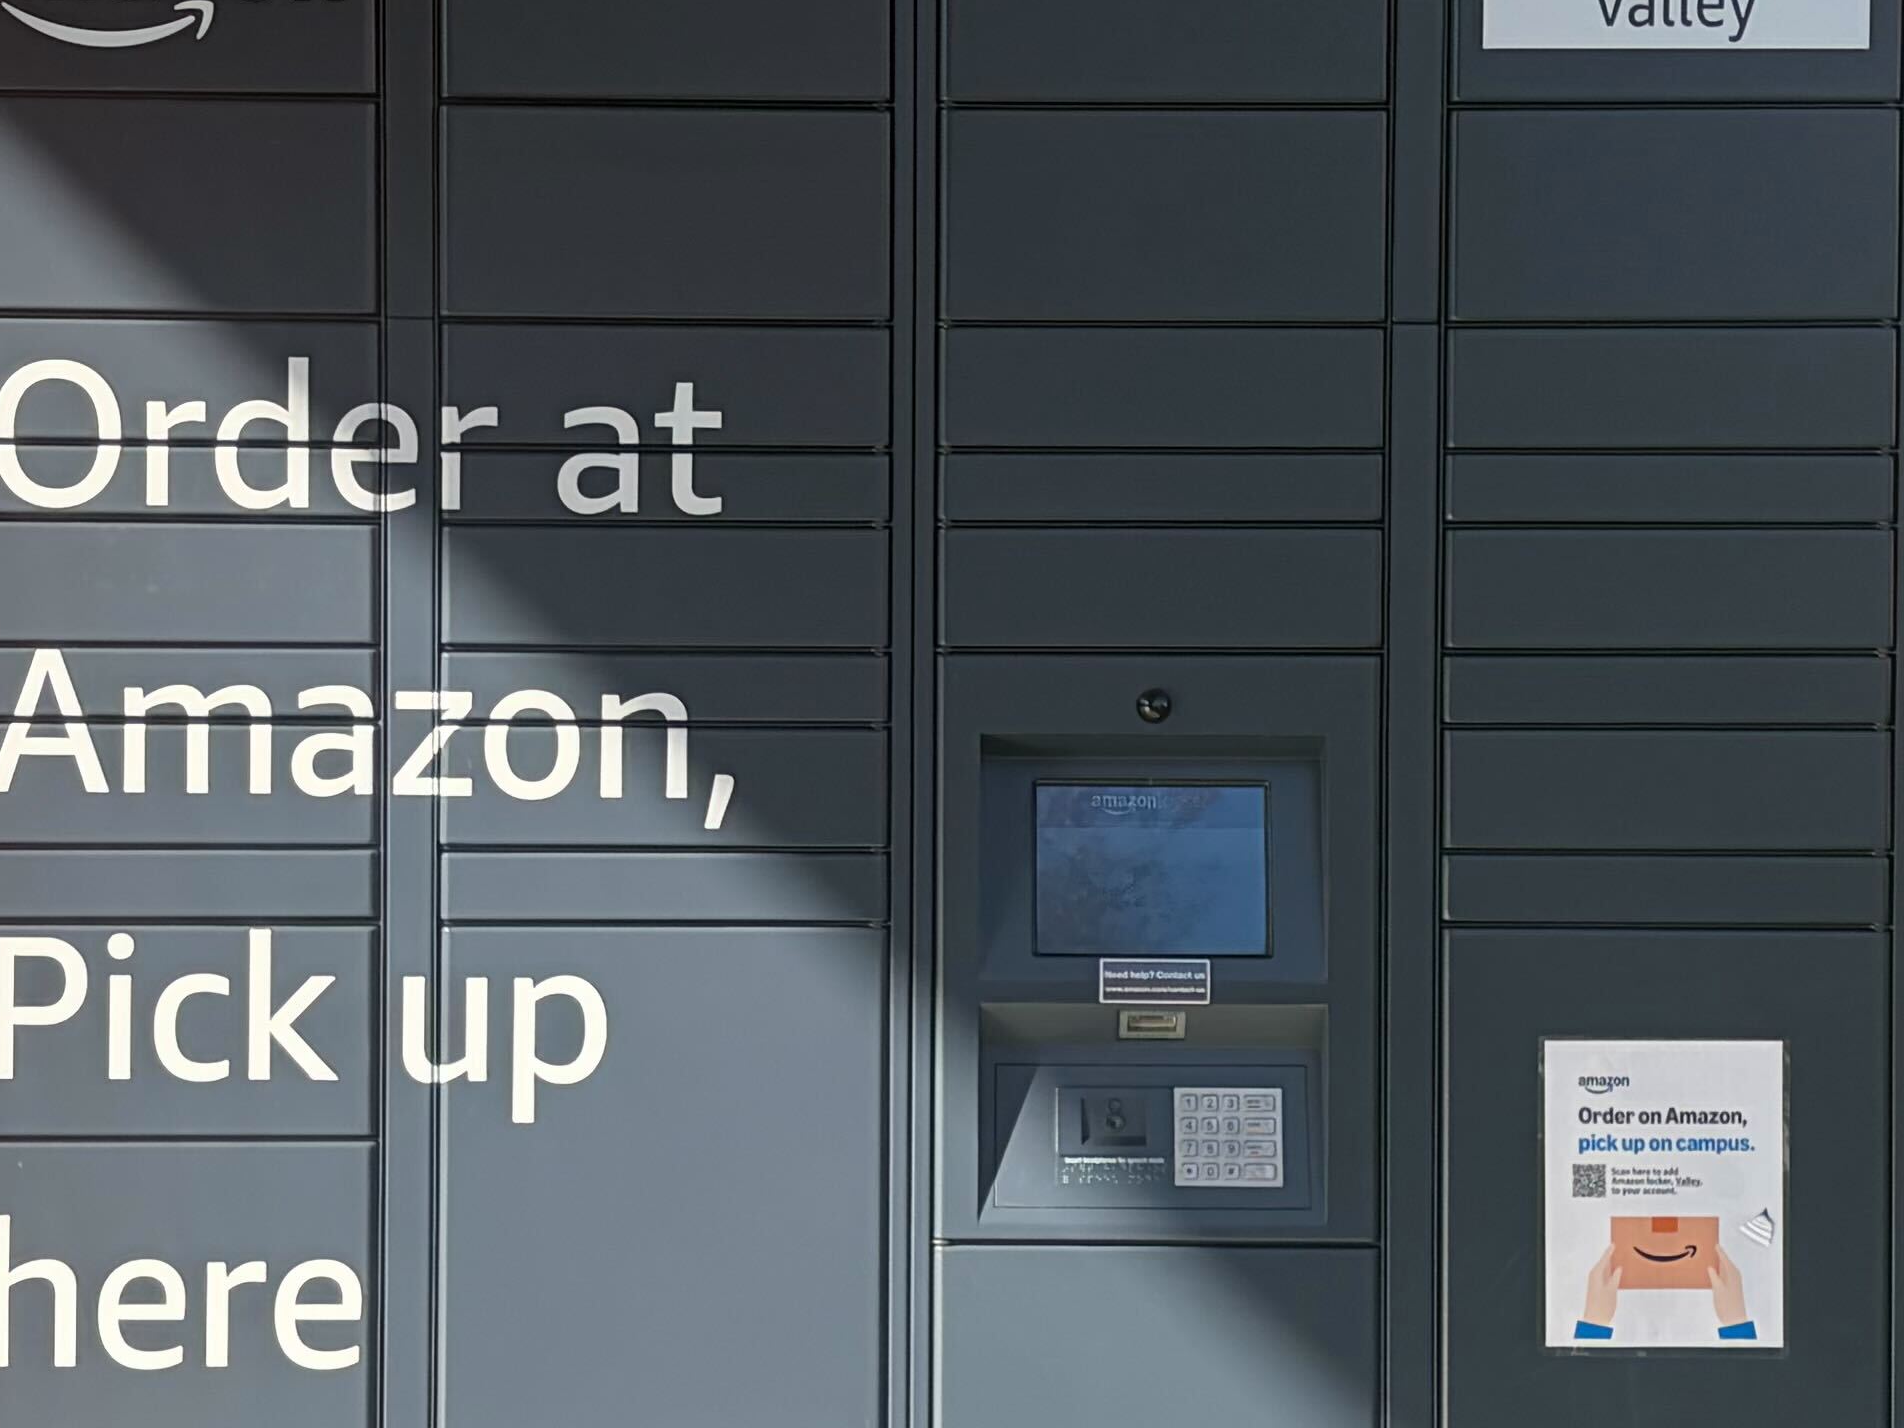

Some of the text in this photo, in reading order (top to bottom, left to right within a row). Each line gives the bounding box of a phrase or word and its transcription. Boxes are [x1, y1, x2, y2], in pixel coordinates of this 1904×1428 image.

[557, 382, 723, 515] at
[1090, 794, 1157, 809] amazon
[1104, 971, 1128, 979] Need
[1130, 970, 1154, 980] help?
[1156, 971, 1192, 979] Contact
[401, 974, 609, 1124] up
[1578, 1076, 1630, 1087] amazon
[1206, 1098, 1214, 1109] 2
[1227, 1098, 1234, 1109] 3
[1578, 1107, 1748, 1128] Order on Amazon,
[1185, 1121, 1193, 1131] 4
[1186, 1143, 1193, 1154] 7
[1578, 1134, 1756, 1154] pick up on campus.
[1652, 1168, 1662, 1176] to
